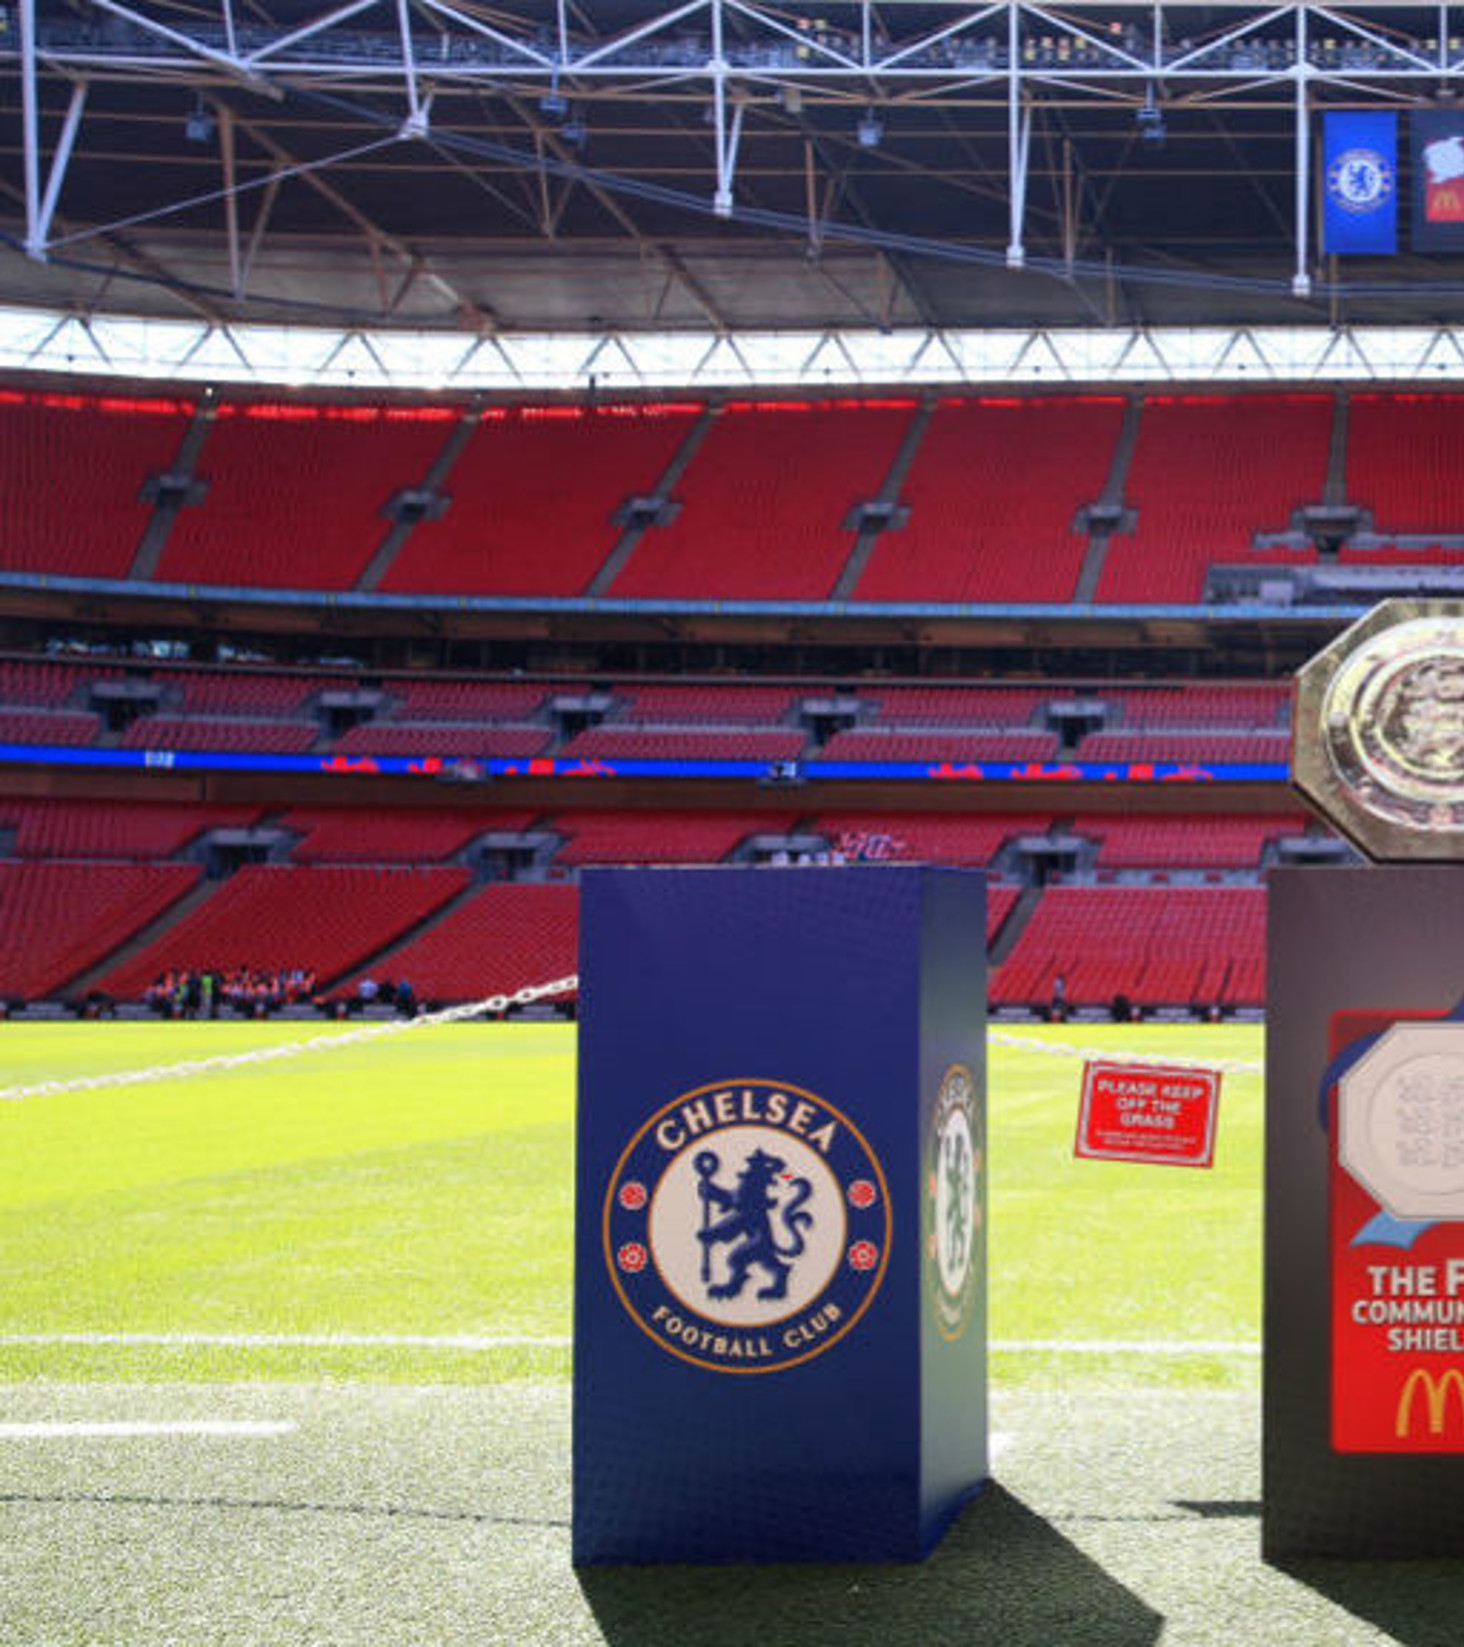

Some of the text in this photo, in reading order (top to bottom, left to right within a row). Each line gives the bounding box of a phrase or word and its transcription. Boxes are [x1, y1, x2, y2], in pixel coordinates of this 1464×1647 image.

[1097, 1080, 1204, 1099] PLEASE KEEP
[1117, 1097, 1181, 1113] OFF THE
[655, 1091, 838, 1153] CHELSEA
[1121, 1114, 1175, 1129] GRASS
[1366, 1266, 1436, 1296] THE
[652, 1303, 843, 1357] FOOTBALL CLUB
